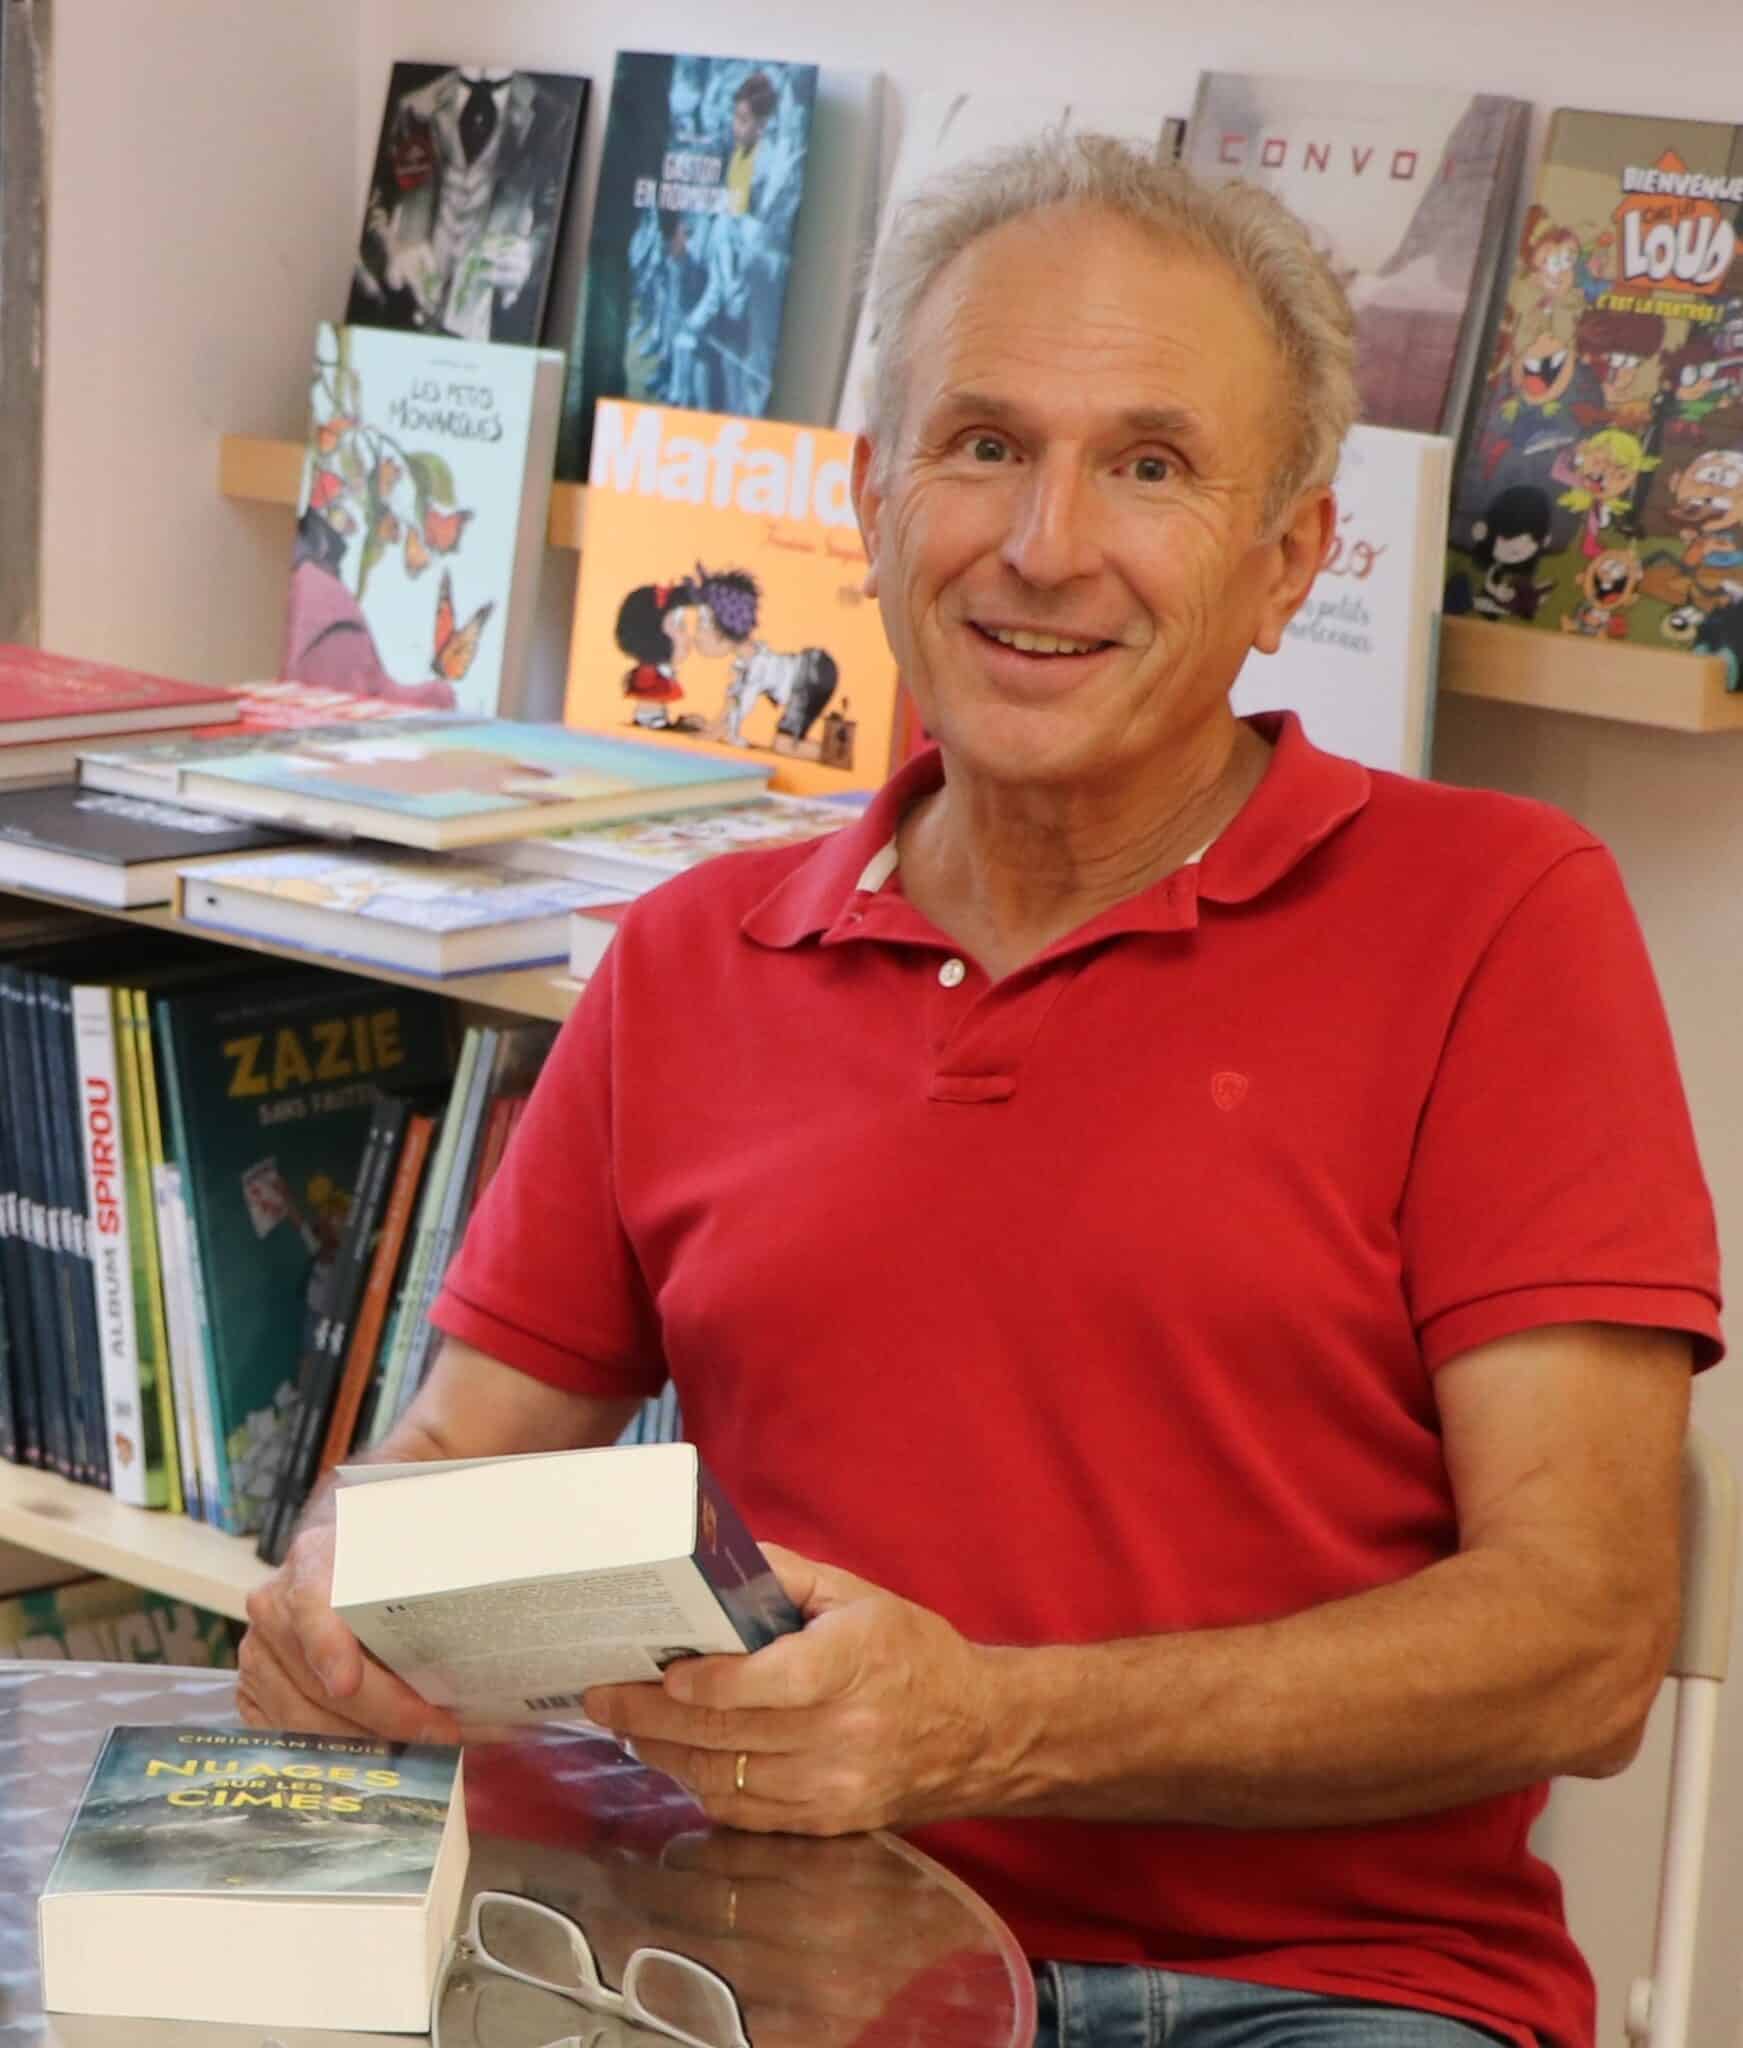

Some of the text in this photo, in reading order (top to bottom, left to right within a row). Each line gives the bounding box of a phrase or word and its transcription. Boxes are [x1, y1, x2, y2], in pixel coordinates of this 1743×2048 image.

[1624, 210, 1736, 284] LOUD
[222, 1009, 404, 1098] ZAZIE
[86, 1078, 120, 1234] SPIROU
[177, 1734, 306, 1750] CHRISTIAN
[145, 1759, 401, 1788] NUAGES
[213, 1777, 323, 1792] SUR LES
[167, 1790, 363, 1813] CIMES
